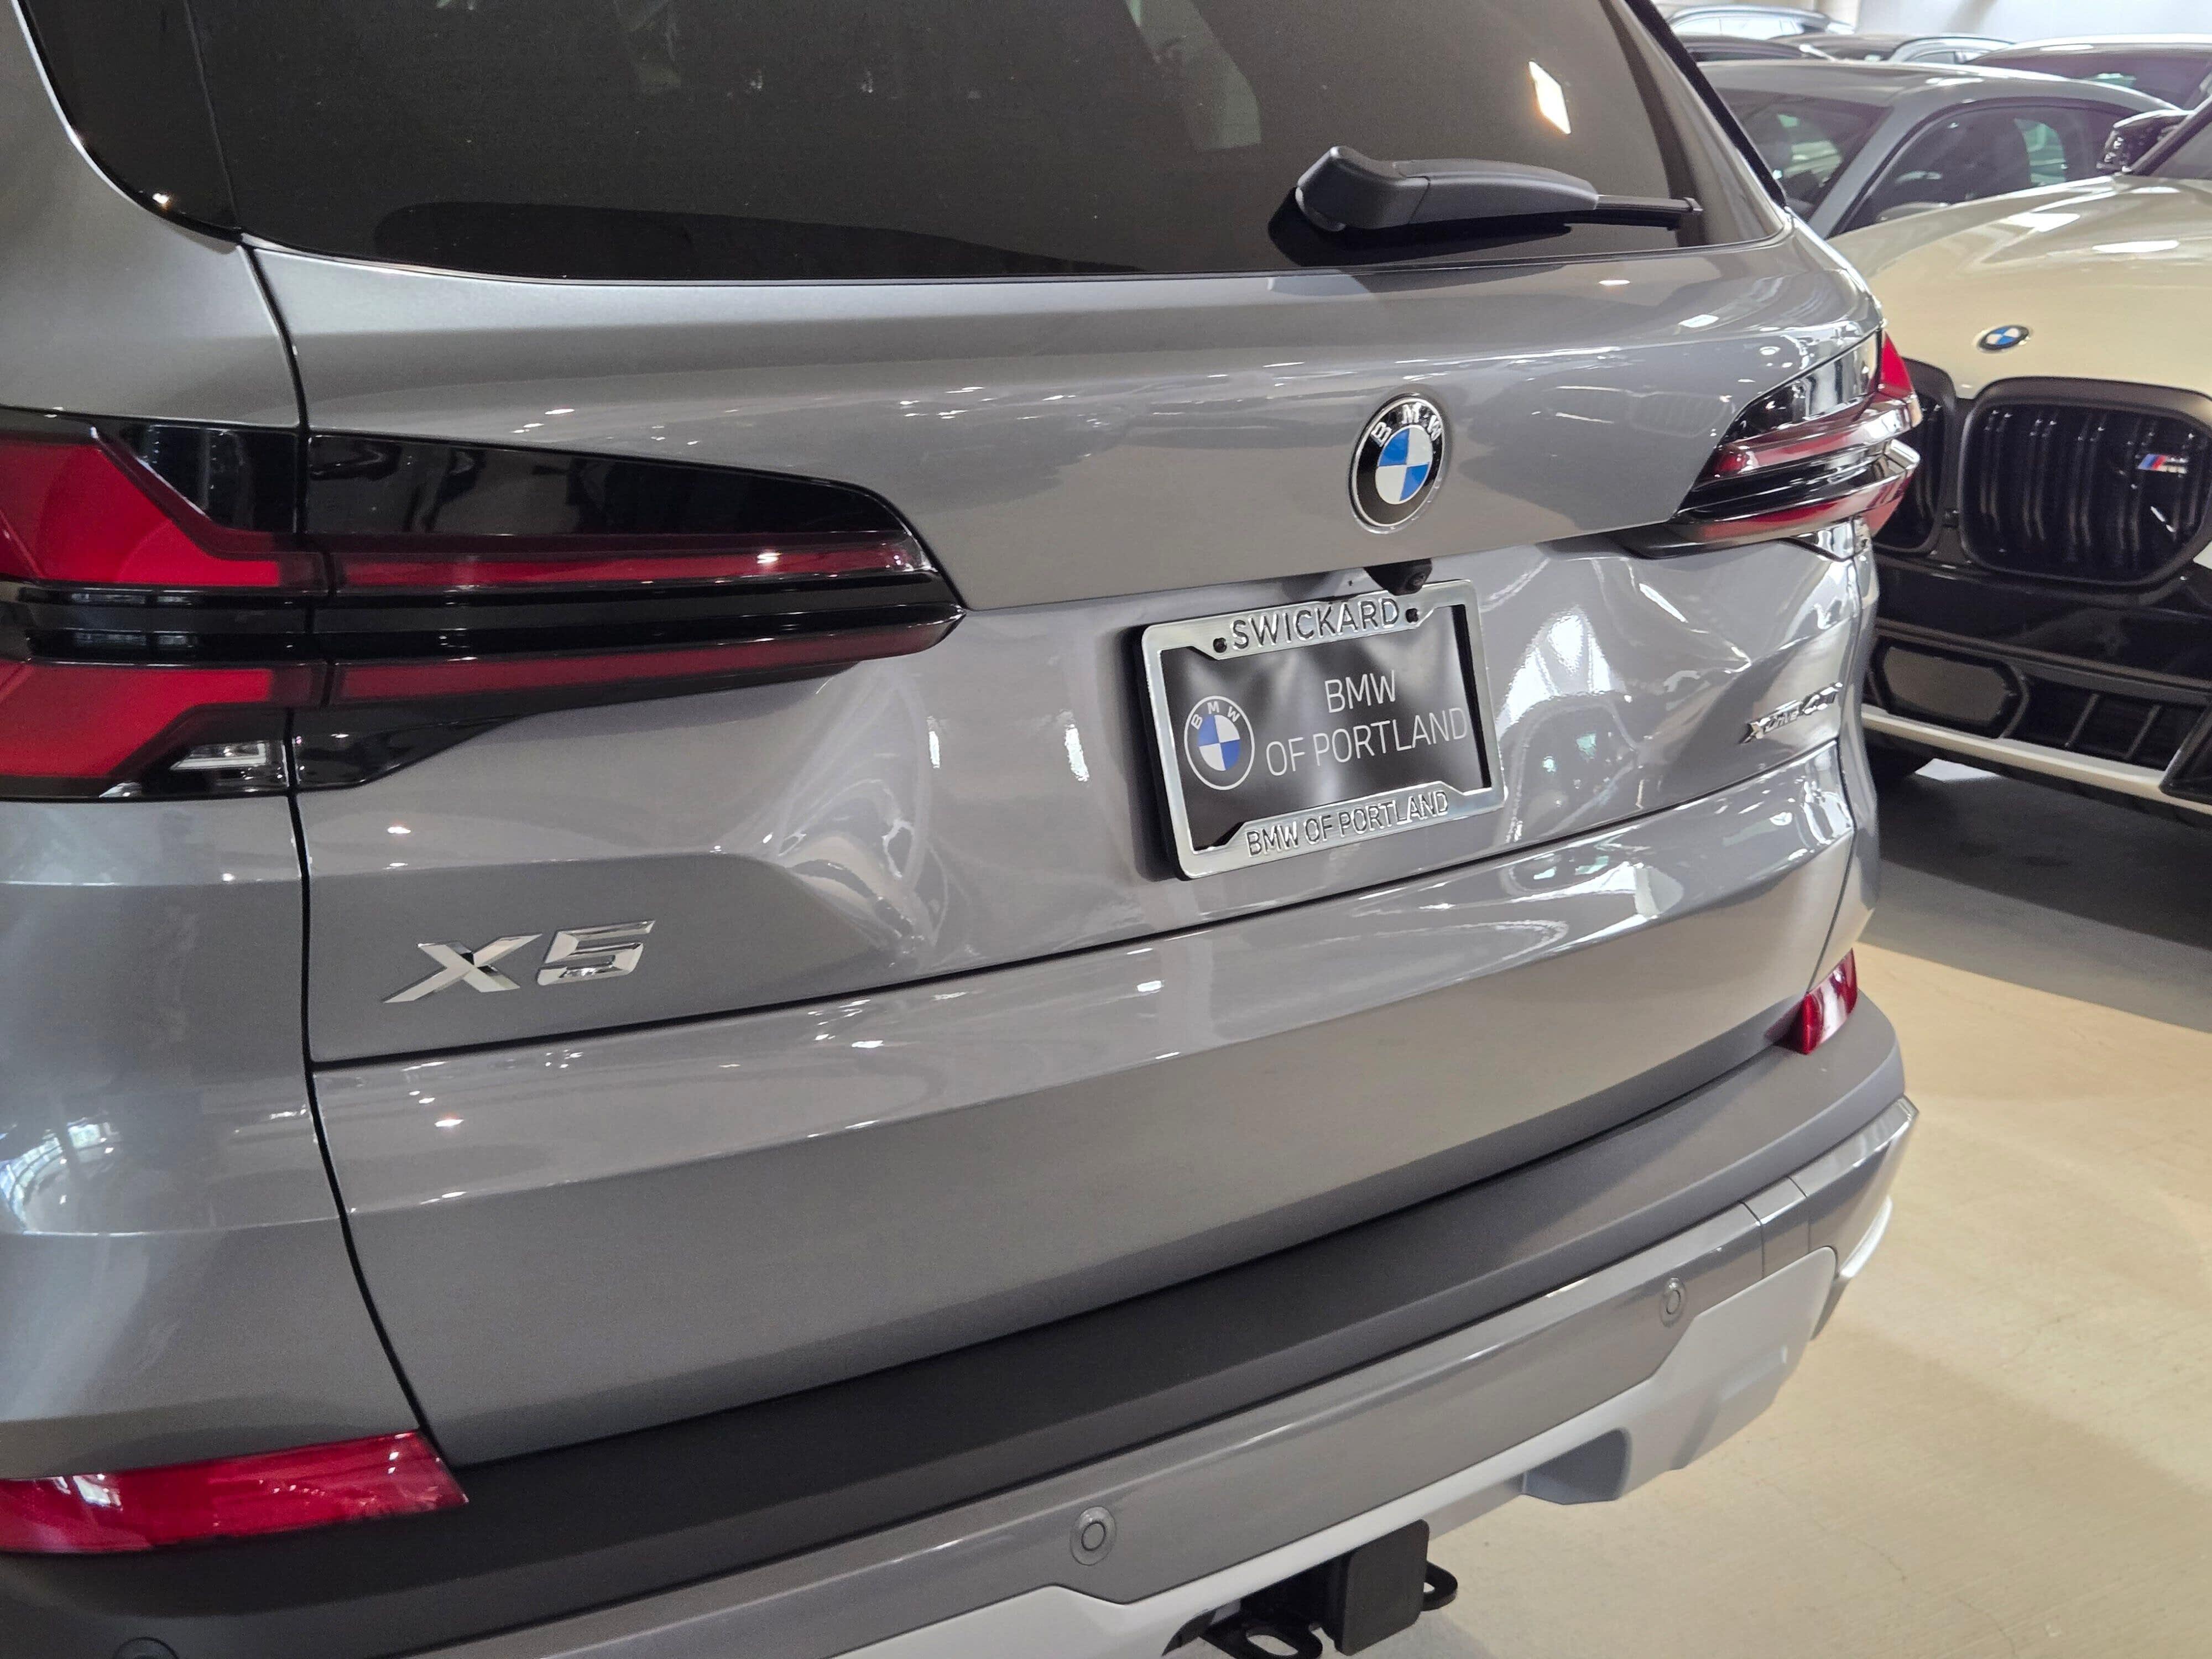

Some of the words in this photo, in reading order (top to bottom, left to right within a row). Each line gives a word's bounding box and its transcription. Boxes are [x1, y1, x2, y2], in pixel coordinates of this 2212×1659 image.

[1371, 402, 1442, 447] BMW
[1230, 598, 1400, 650] SWICKARD
[1191, 702, 1240, 729] BMW
[1324, 670, 1396, 713] BMW
[1266, 738, 1306, 776] OF
[1313, 707, 1468, 766] PORTLAND
[1246, 821, 1299, 857] BMW
[1305, 815, 1333, 845] OF
[1339, 791, 1449, 837] PORTLAND
[384, 920, 655, 1003] X5
